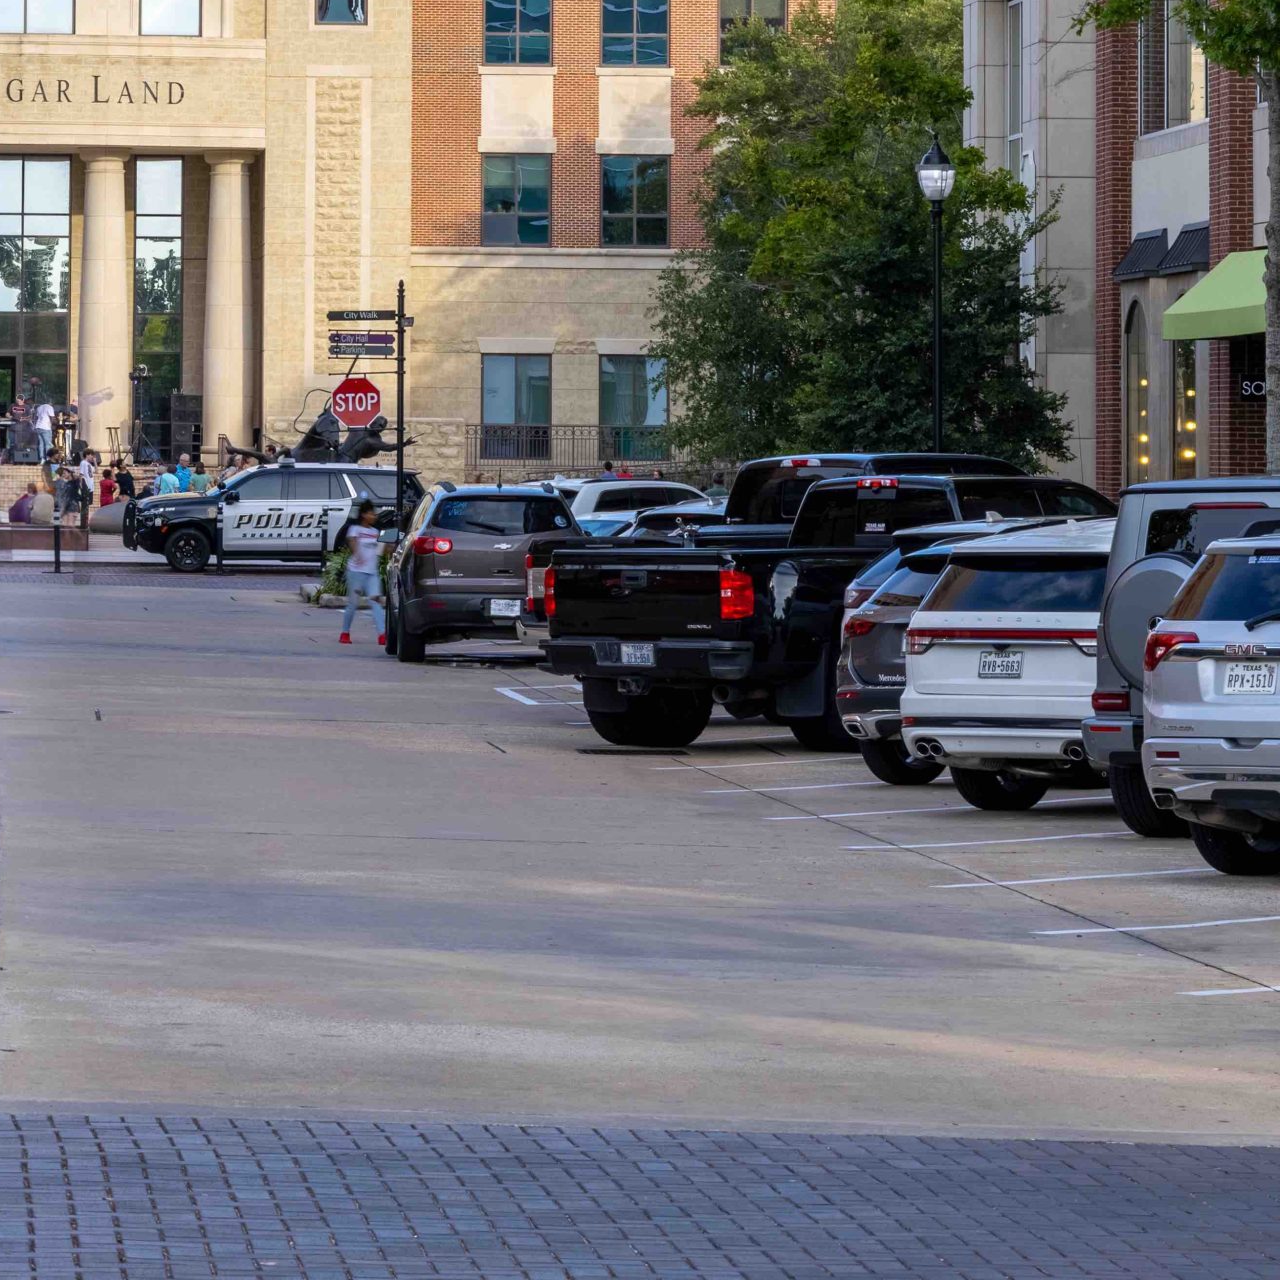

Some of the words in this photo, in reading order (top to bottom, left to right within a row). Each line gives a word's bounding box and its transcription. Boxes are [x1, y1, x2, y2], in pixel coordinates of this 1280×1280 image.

[90, 74, 186, 106] LAND
[343, 311, 358, 320] City
[359, 311, 378, 319] Walk
[340, 335, 355, 344] City
[340, 346, 366, 355] Parking
[335, 392, 378, 412] STOP
[232, 512, 324, 530] POLICE
[1224, 644, 1267, 656] GMC
[994, 651, 1011, 659] TEXAS
[1242, 664, 1262, 672] TEXAS
